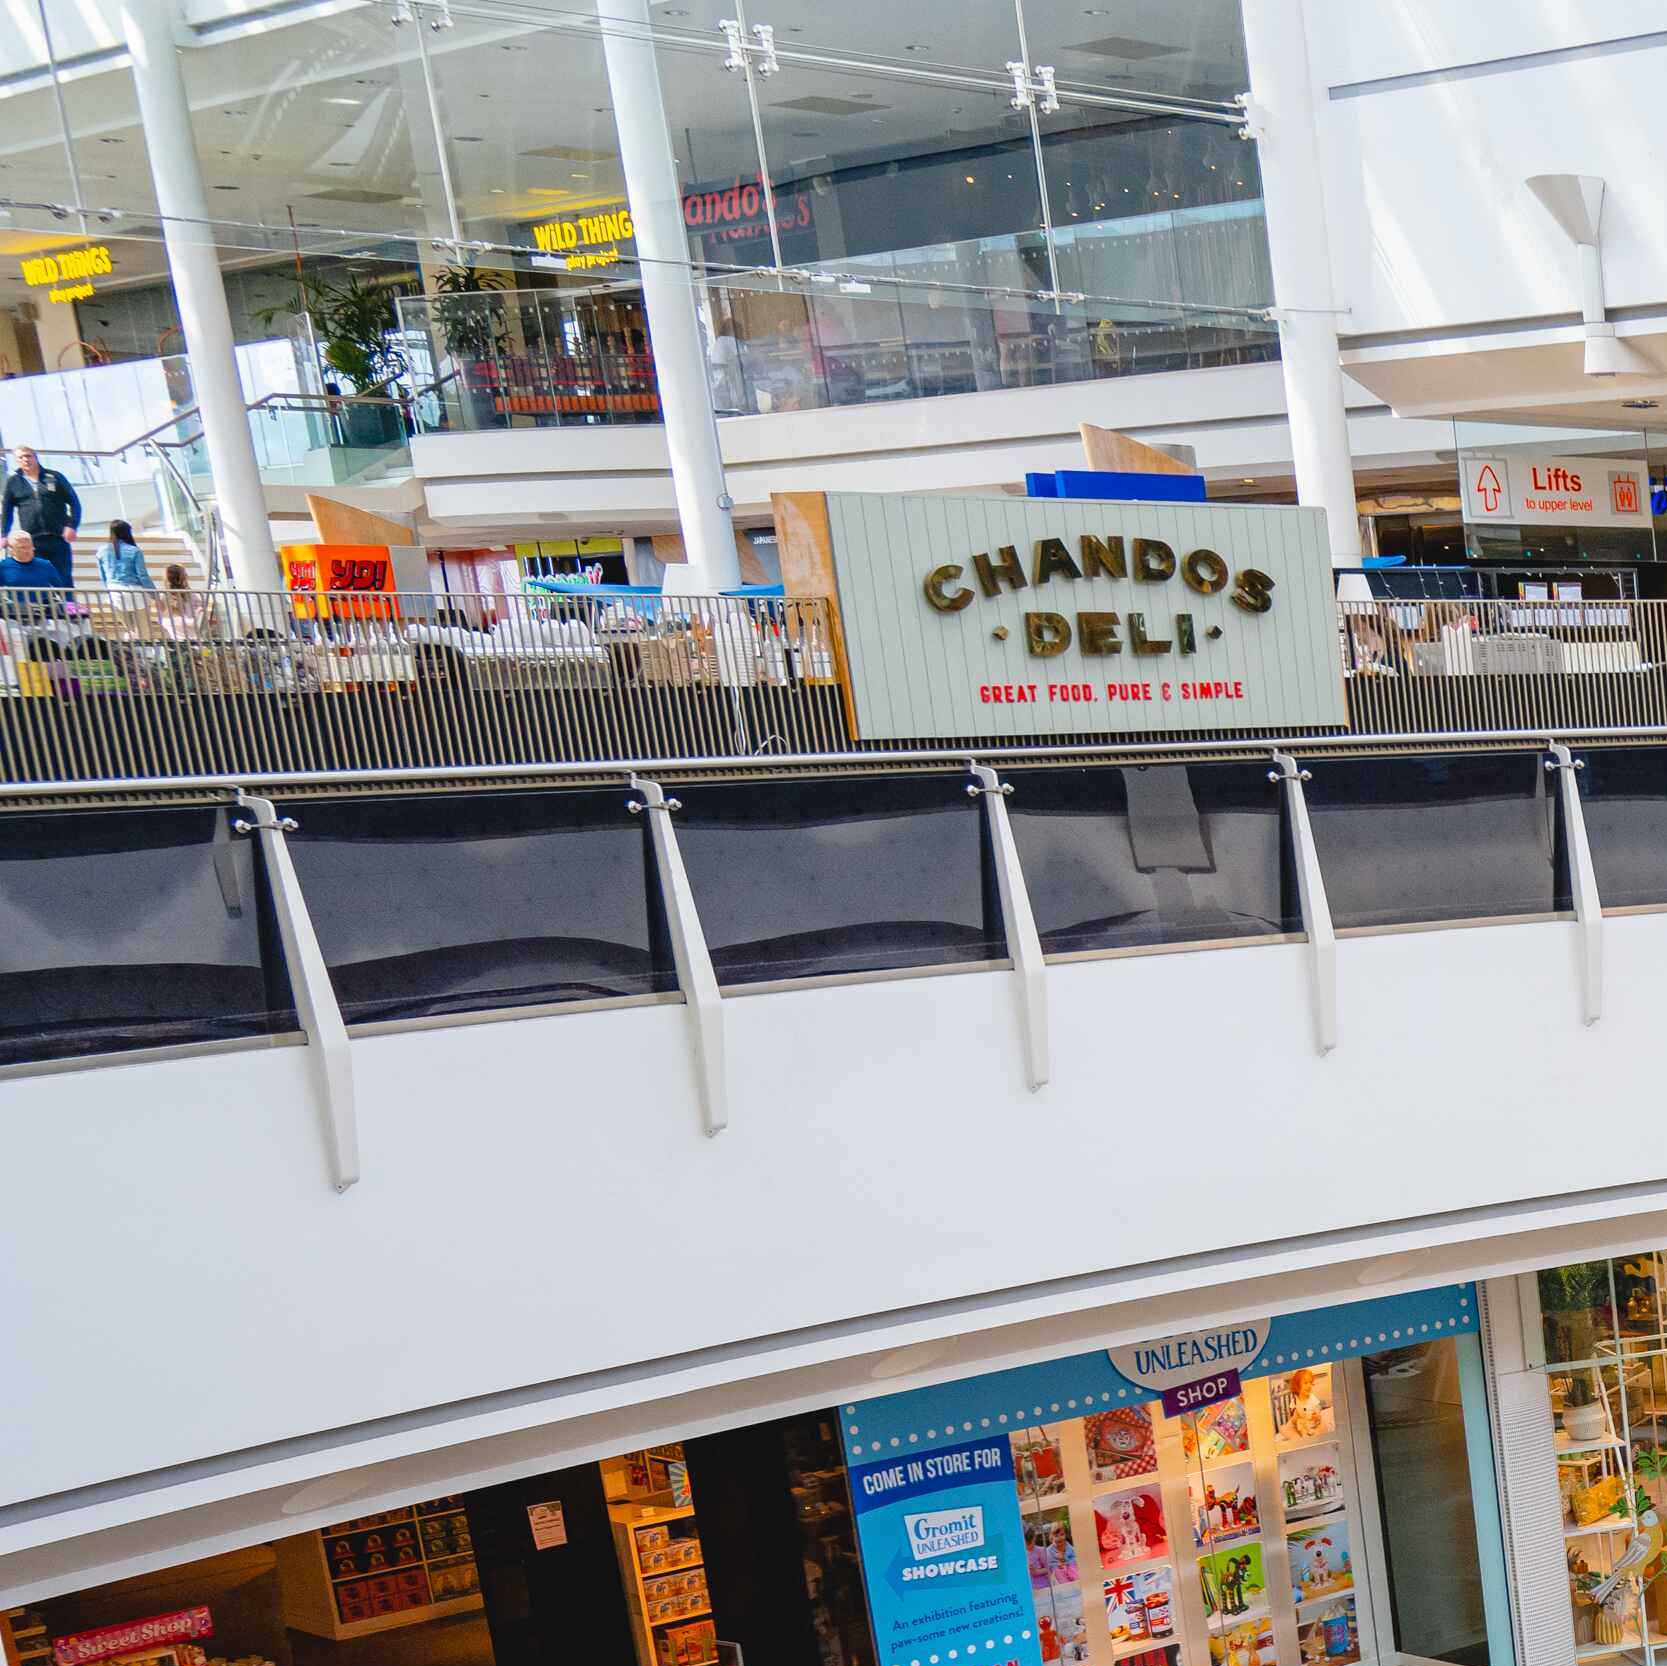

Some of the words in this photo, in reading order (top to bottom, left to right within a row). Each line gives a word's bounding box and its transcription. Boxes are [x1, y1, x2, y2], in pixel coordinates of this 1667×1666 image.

[682, 168, 776, 226] ando's
[1531, 466, 1583, 493] Lifts
[1526, 498, 1536, 511] to
[1538, 499, 1567, 514] upper
[1569, 499, 1593, 513] level
[923, 534, 1276, 614] CHANDOS
[1024, 611, 1197, 657] DELI
[979, 684, 1038, 704] GREAT
[1107, 682, 1152, 702] PURE
[1182, 681, 1245, 700] SIMPLE
[1134, 1328, 1257, 1375] UNLEASHED
[1177, 1377, 1228, 1407] SHOP
[863, 1466, 906, 1495] COME
[907, 1461, 924, 1483] IN
[926, 1452, 972, 1479] STORE
[974, 1448, 1001, 1469] FOR
[913, 1513, 977, 1541] Gromit
[916, 1530, 979, 1555] UNLEASHED
[902, 1556, 998, 1582] SHOWCASE
[891, 1627, 945, 1654] paw-some
[948, 1624, 970, 1635] new
[972, 1606, 1024, 1629] creations!
[893, 1620, 909, 1632] An
[912, 1606, 967, 1627] exhibition
[969, 1593, 1019, 1612] featuring
[78, 1630, 138, 1659] Sweet
[141, 1617, 192, 1641] Shop
